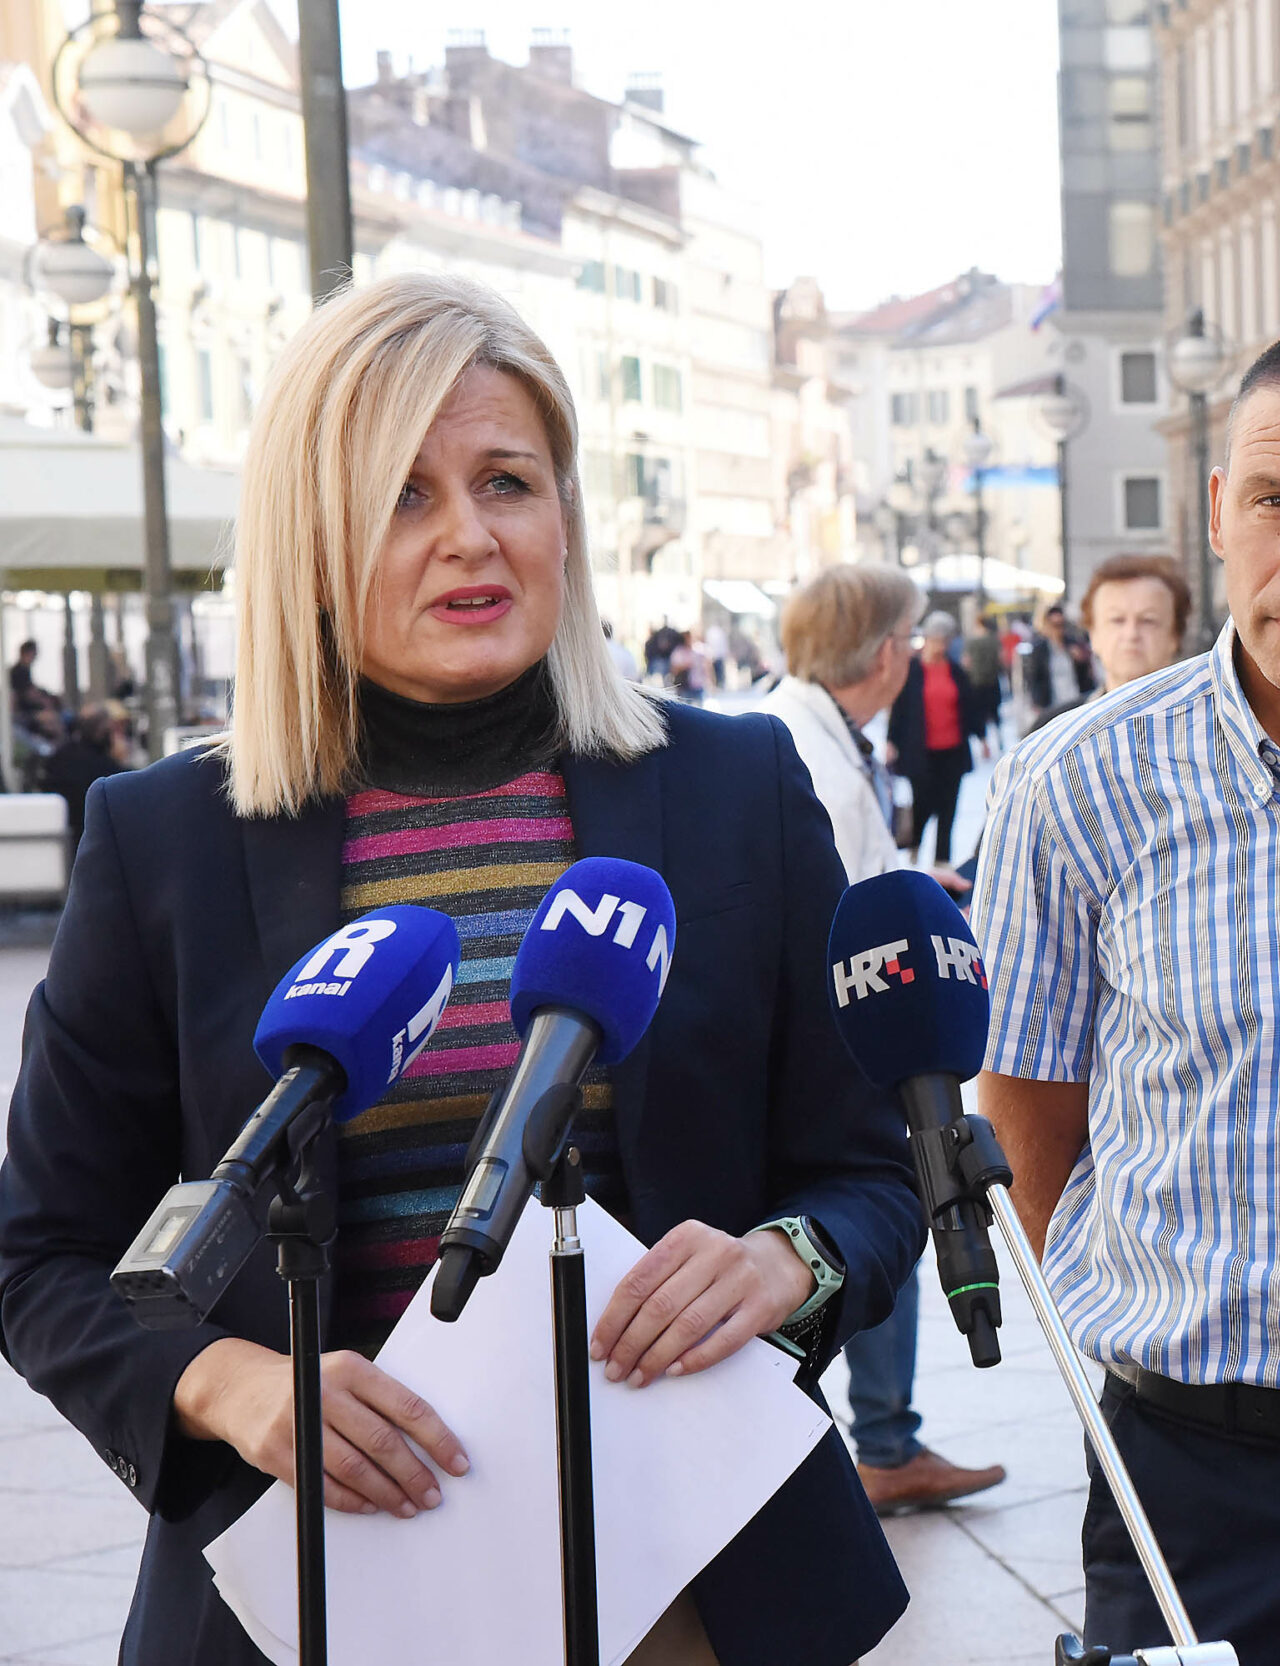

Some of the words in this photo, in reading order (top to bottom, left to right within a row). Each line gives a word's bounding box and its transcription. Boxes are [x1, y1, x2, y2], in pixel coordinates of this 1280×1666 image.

[540, 888, 647, 949] N1
[295, 919, 397, 982] R
[284, 981, 352, 1000] kanal
